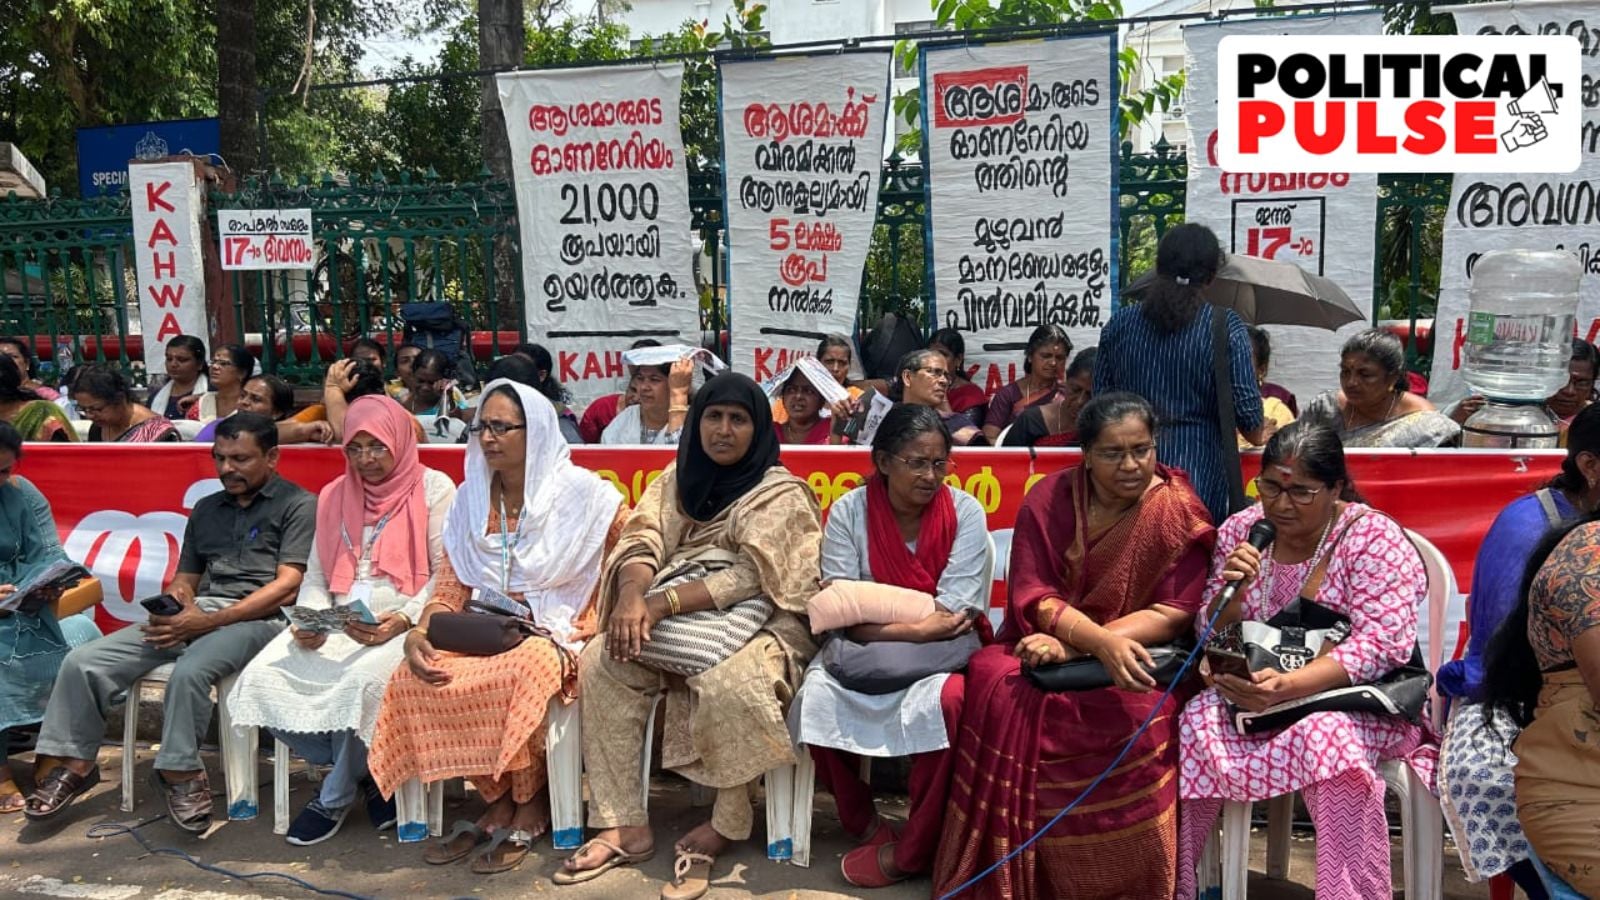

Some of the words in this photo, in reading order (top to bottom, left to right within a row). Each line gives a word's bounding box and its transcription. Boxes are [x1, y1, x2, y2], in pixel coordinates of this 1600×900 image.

[529, 98, 662, 136] ആശമാരുടെ
[950, 114, 1089, 160] ഓണറേറിയ
[531, 131, 674, 175] ഓണറേറിയം
[755, 139, 855, 174] വിരമിക്കൽ
[559, 182, 659, 227] 21,000
[1255, 204, 1297, 225] ഇന്ന്
[1457, 181, 1600, 227] അവഗ
[559, 225, 660, 265] രൂപയായി
[769, 218, 791, 251] 5
[794, 221, 842, 251] ലക്ഷം
[973, 211, 1064, 252] മുഴുവൻ
[146, 181, 185, 342] KAHWA
[780, 253, 827, 286] രൂപ
[559, 351, 624, 383] KAH
